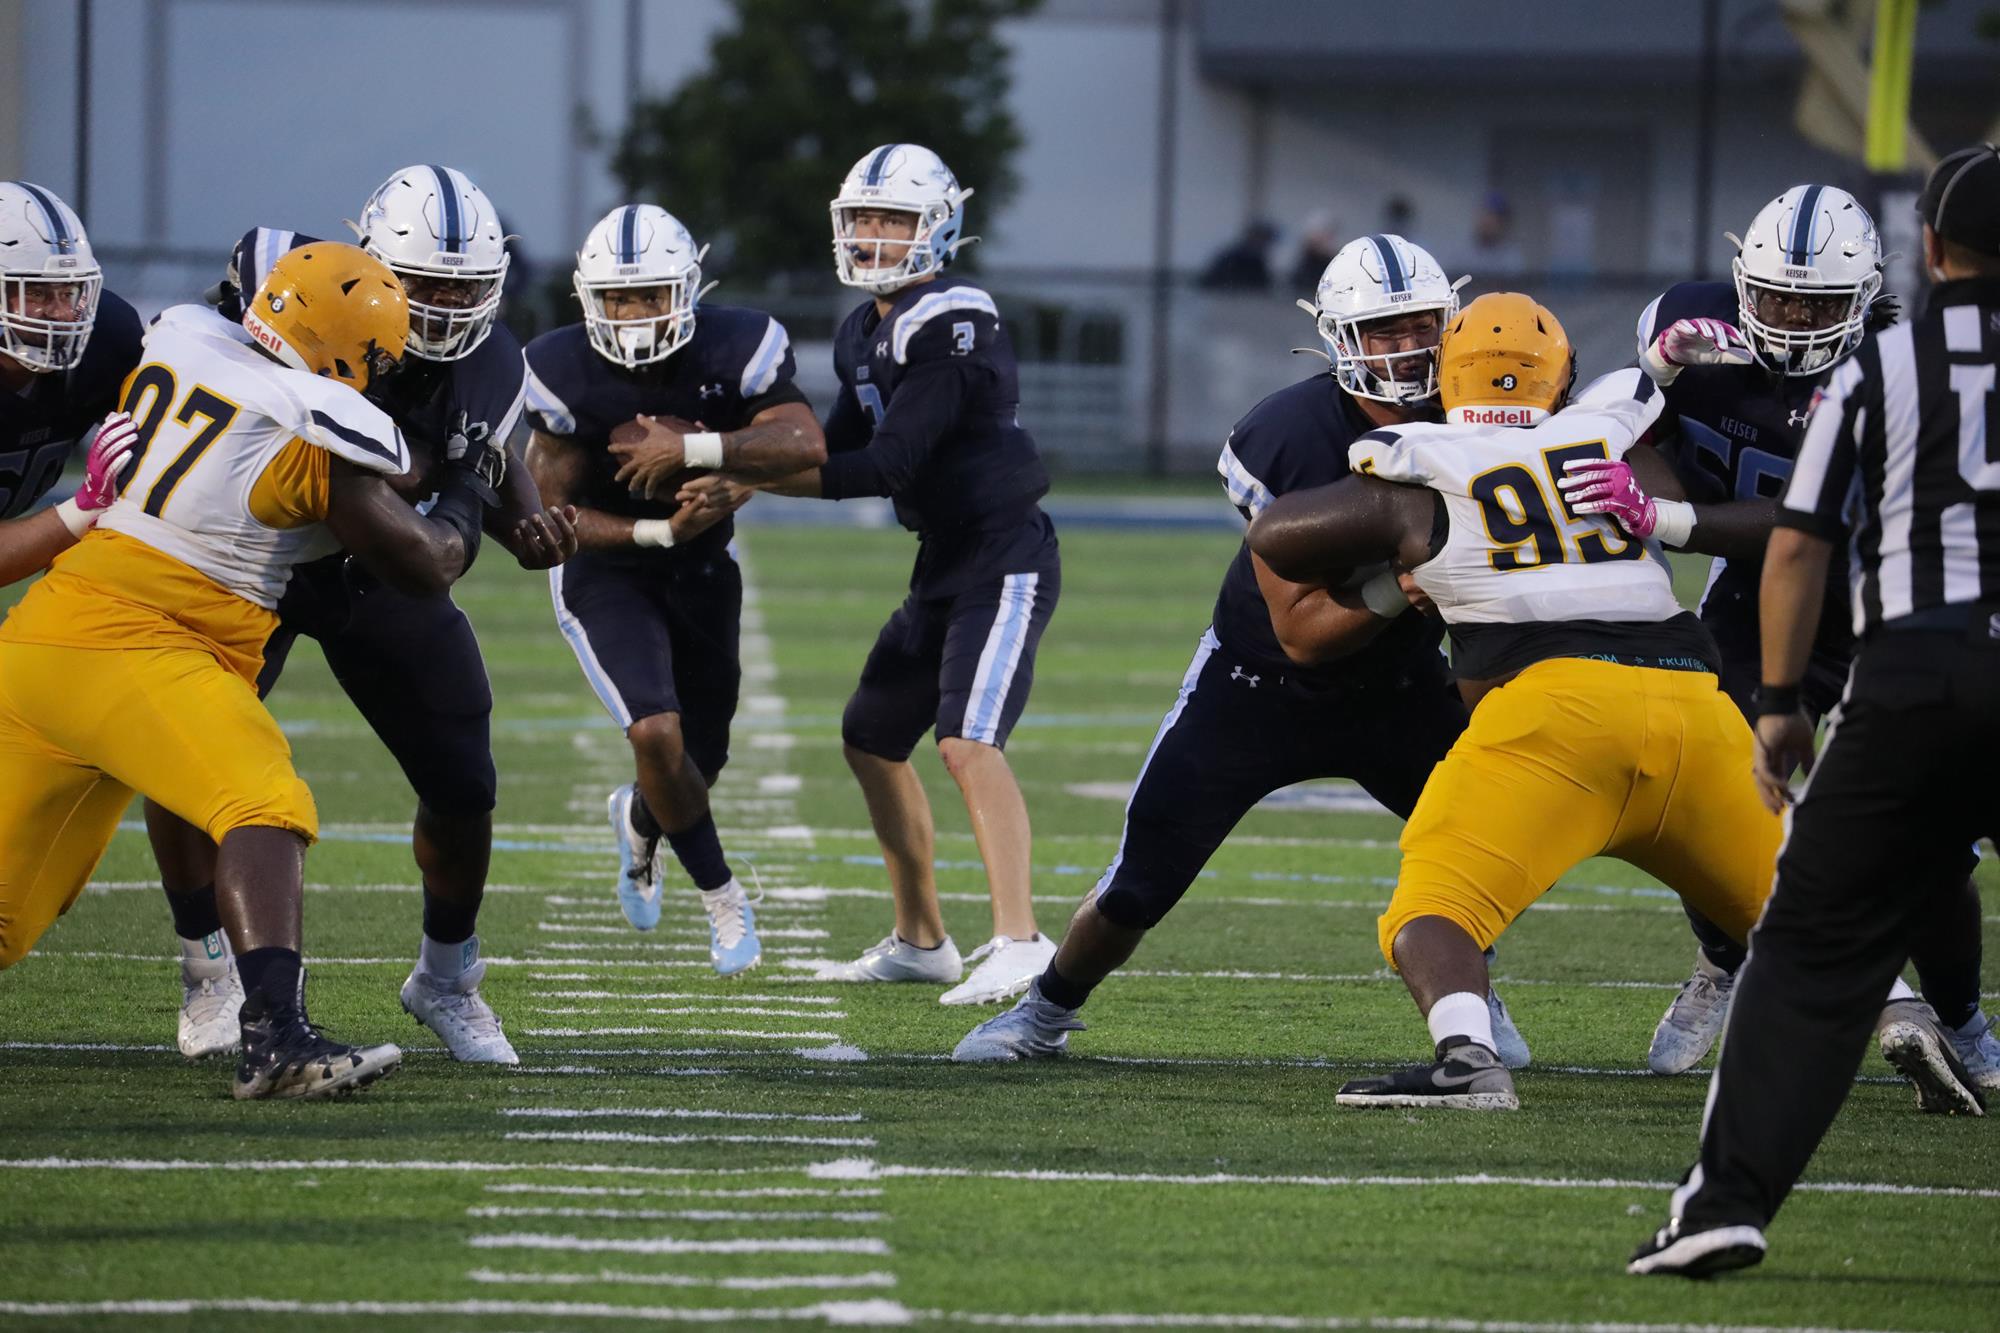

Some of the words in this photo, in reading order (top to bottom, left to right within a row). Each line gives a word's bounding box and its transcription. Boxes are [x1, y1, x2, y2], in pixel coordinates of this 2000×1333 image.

[442, 257, 465, 266] KEISER
[1785, 268, 1808, 279] KEISER
[1390, 293, 1412, 303] KEISER
[244, 311, 282, 353] ddell
[952, 321, 975, 356] 3
[1463, 409, 1532, 424] Riddell
[1720, 415, 1759, 442] KEISER
[1468, 438, 1647, 572] 95
